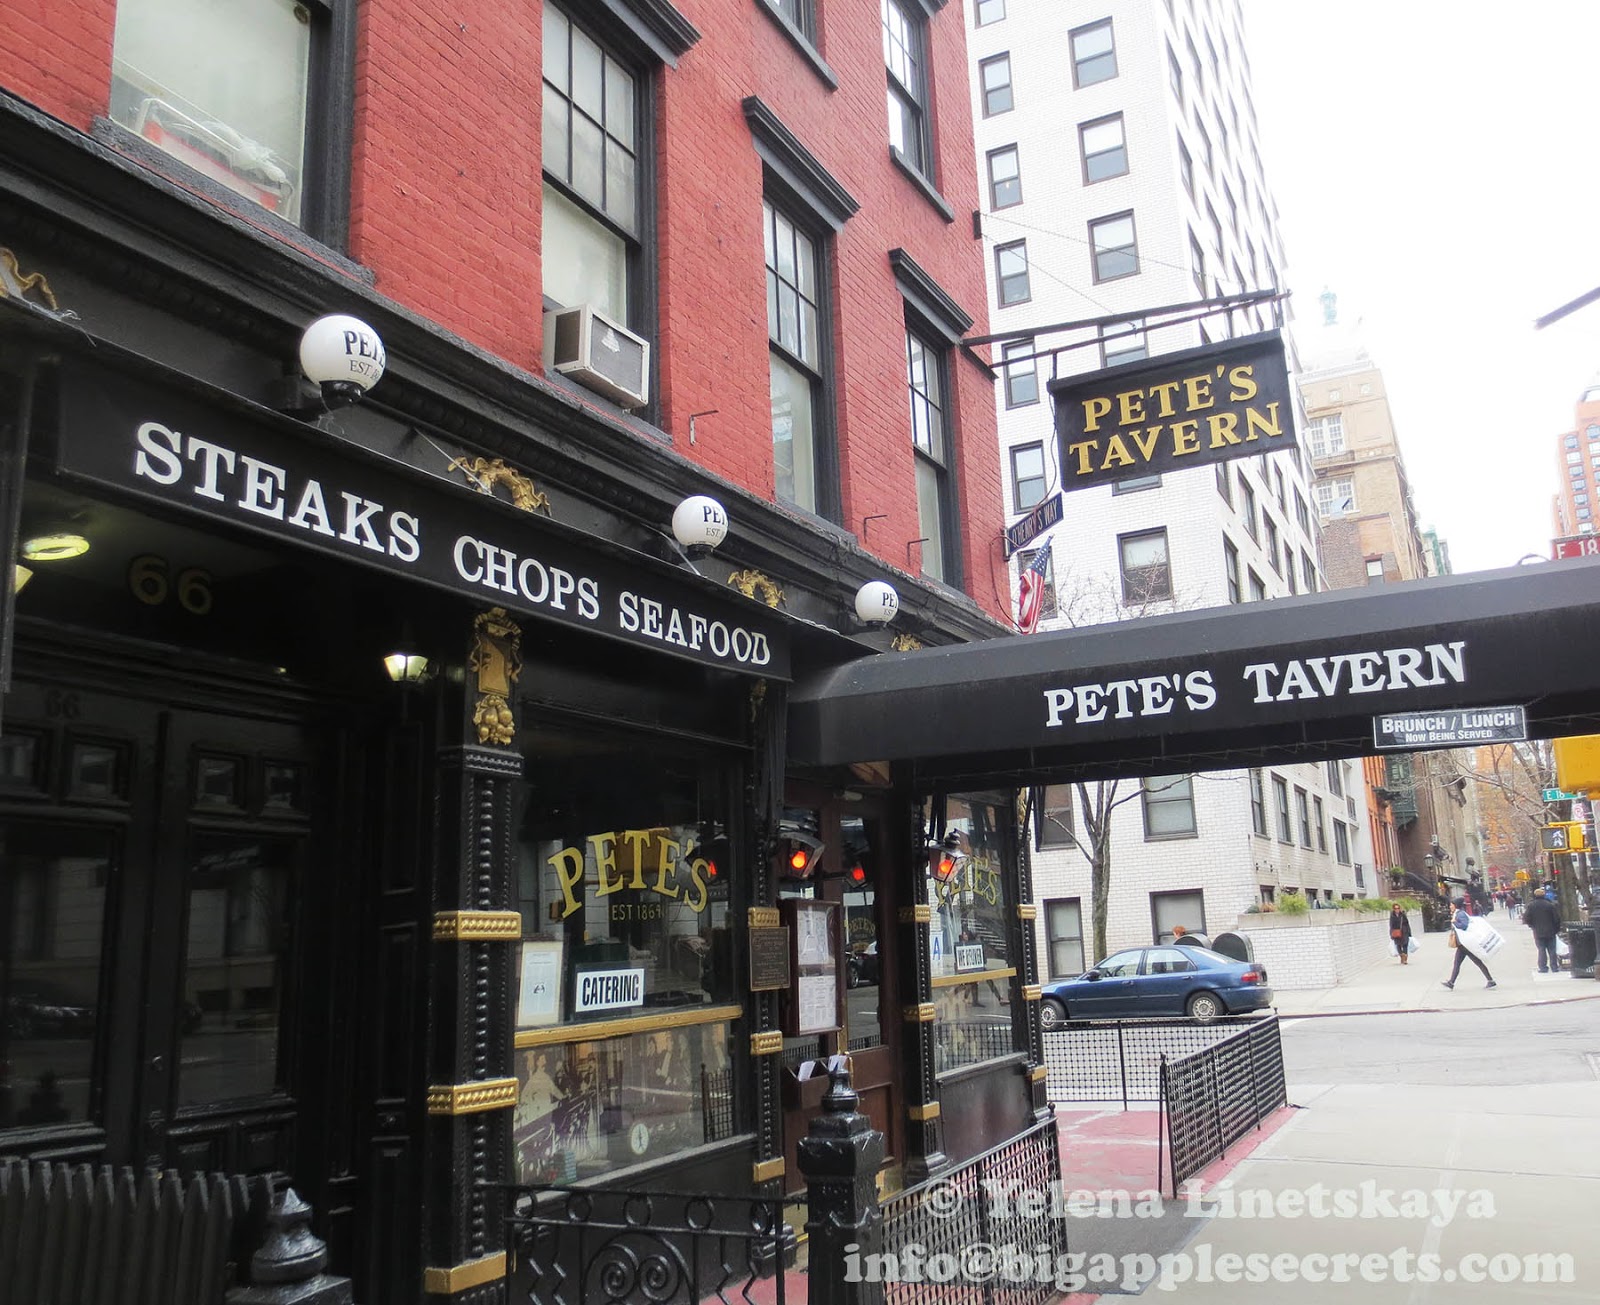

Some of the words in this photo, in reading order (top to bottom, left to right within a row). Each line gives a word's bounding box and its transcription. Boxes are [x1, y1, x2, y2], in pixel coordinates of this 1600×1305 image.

[1082, 365, 1257, 432] PETE'S
[1069, 401, 1283, 475] TAVERN
[135, 422, 421, 562] STEAKS
[453, 535, 600, 620] CHOPS
[619, 591, 771, 665] SEAFOOD
[1044, 499, 1057, 526] WAY
[128, 555, 212, 614] 66
[1043, 670, 1217, 727] PETE'S
[1242, 641, 1466, 703] TAVERN
[1381, 717, 1446, 734] BRUNCH
[1461, 712, 1516, 729] LUNCH
[547, 829, 712, 919] PETE'S
[611, 903, 633, 921] EST
[582, 973, 640, 1007] CATERING
